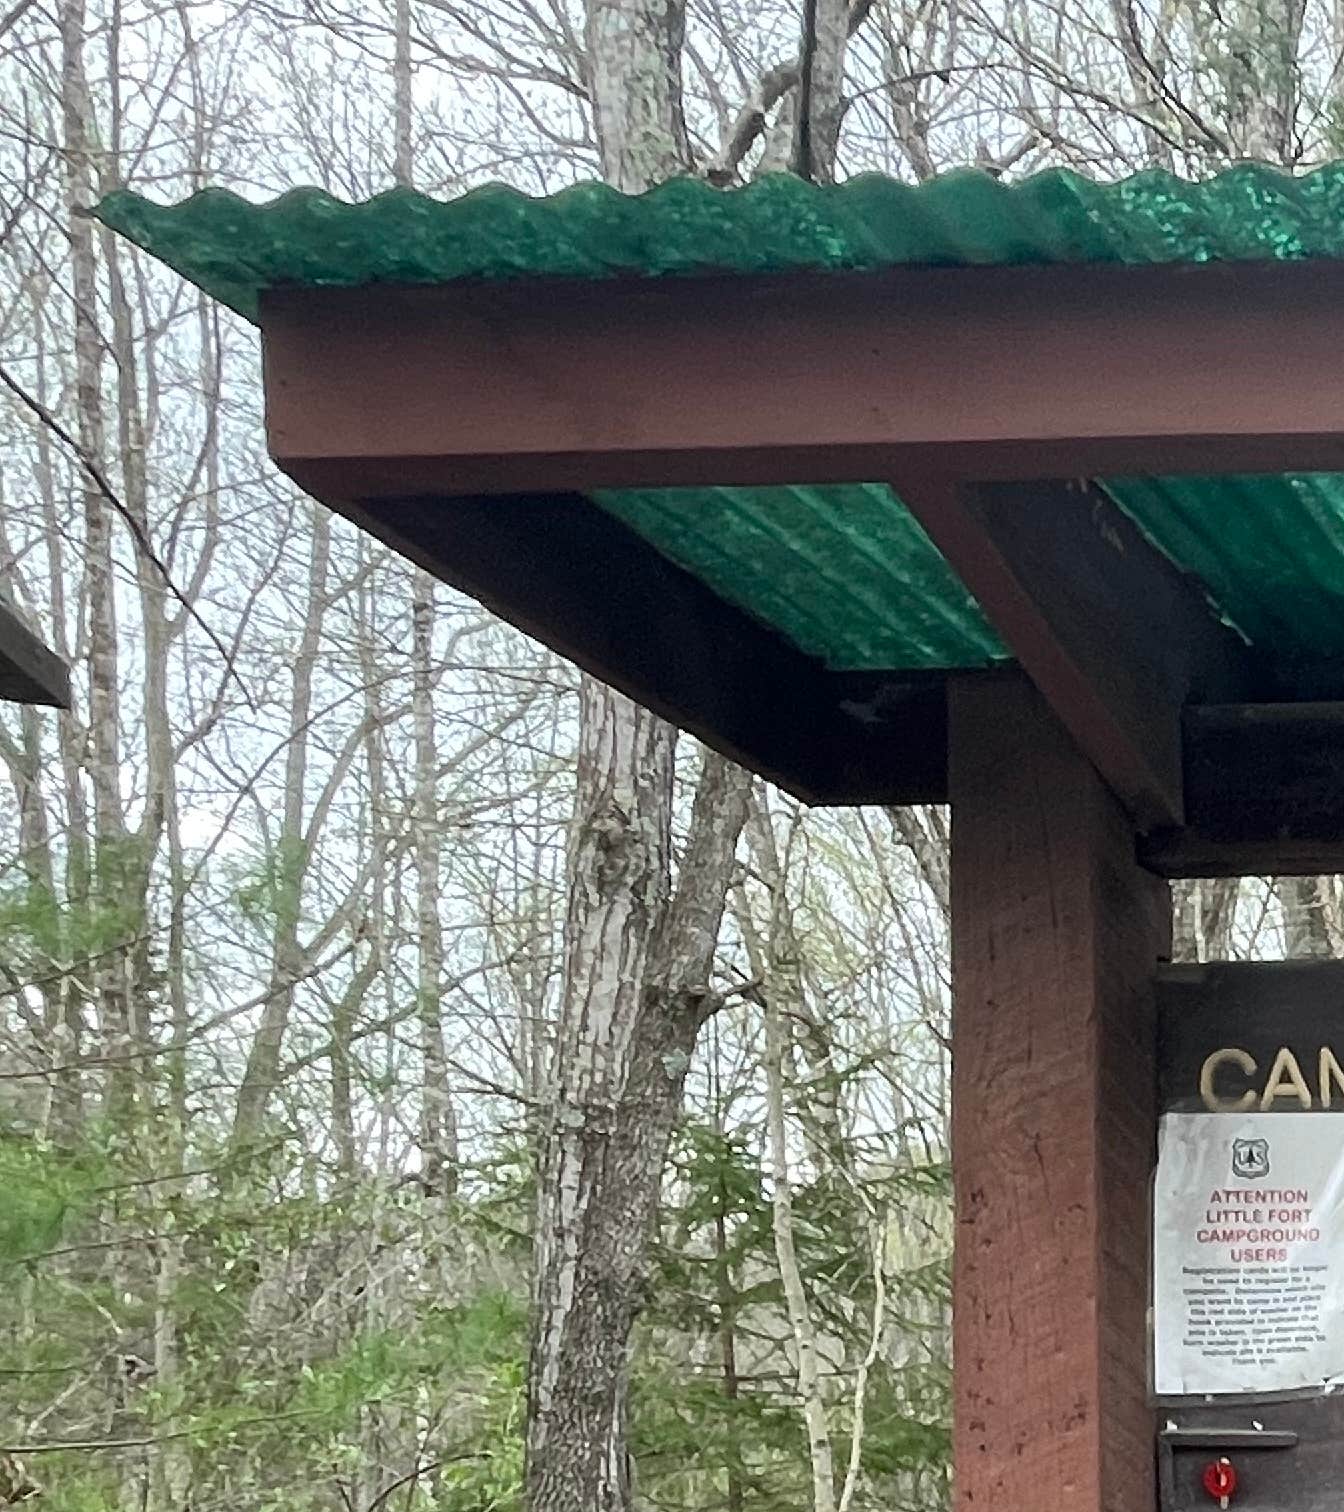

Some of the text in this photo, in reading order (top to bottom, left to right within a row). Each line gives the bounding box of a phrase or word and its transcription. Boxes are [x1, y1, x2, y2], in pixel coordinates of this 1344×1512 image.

[1210, 1189, 1308, 1204] ATTENTION
[1206, 1208, 1313, 1224] LITTLE FORT
[1196, 1228, 1320, 1244] CAMPGROUND
[1230, 1248, 1288, 1263] USERS
